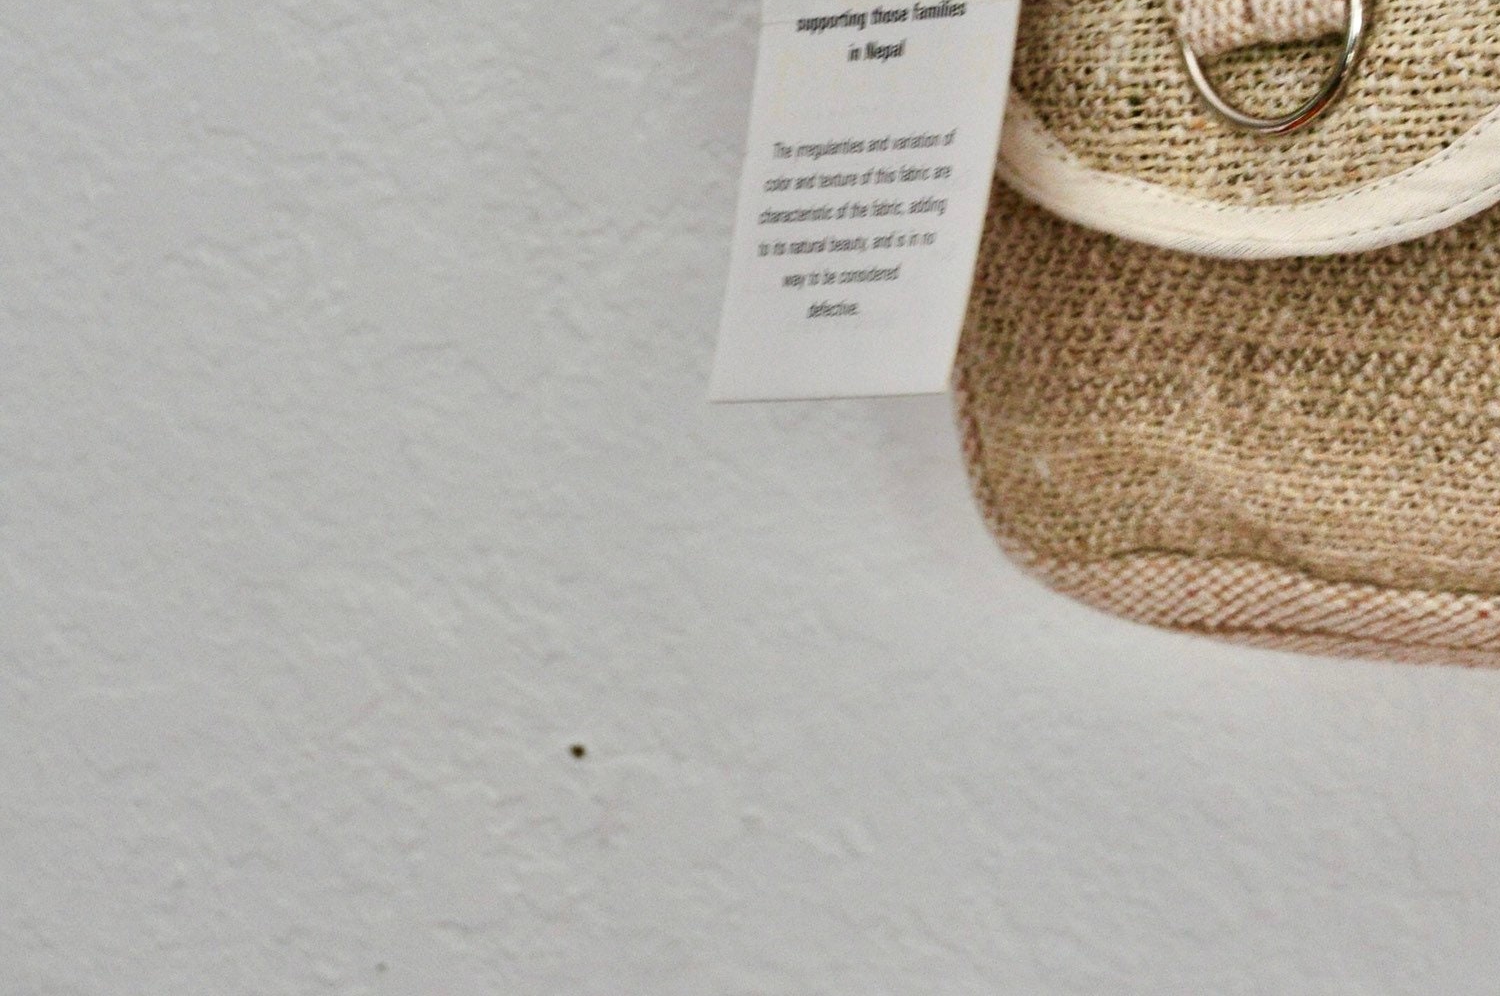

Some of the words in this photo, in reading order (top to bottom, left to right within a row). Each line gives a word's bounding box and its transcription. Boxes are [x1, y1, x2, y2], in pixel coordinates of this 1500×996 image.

[797, 10, 868, 34] supporting
[912, 0, 968, 21] families
[847, 44, 861, 61] in
[864, 39, 906, 63] Nepal
[773, 142, 792, 158] The
[868, 135, 890, 151] and
[893, 132, 940, 149] variation
[944, 128, 958, 146] of
[764, 175, 792, 192] color
[794, 174, 816, 189] and
[818, 172, 858, 188] texture
[860, 167, 874, 185] of
[899, 166, 930, 182] fabric
[933, 165, 952, 179] are
[836, 203, 849, 220] of
[851, 204, 867, 219] the
[908, 197, 948, 216] adding
[758, 241, 771, 256] to
[790, 237, 826, 254] natural
[873, 232, 893, 249] and
[896, 233, 906, 248] is
[908, 232, 919, 246] in
[782, 274, 806, 288] way
[807, 272, 820, 286] to
[821, 269, 836, 285] be
